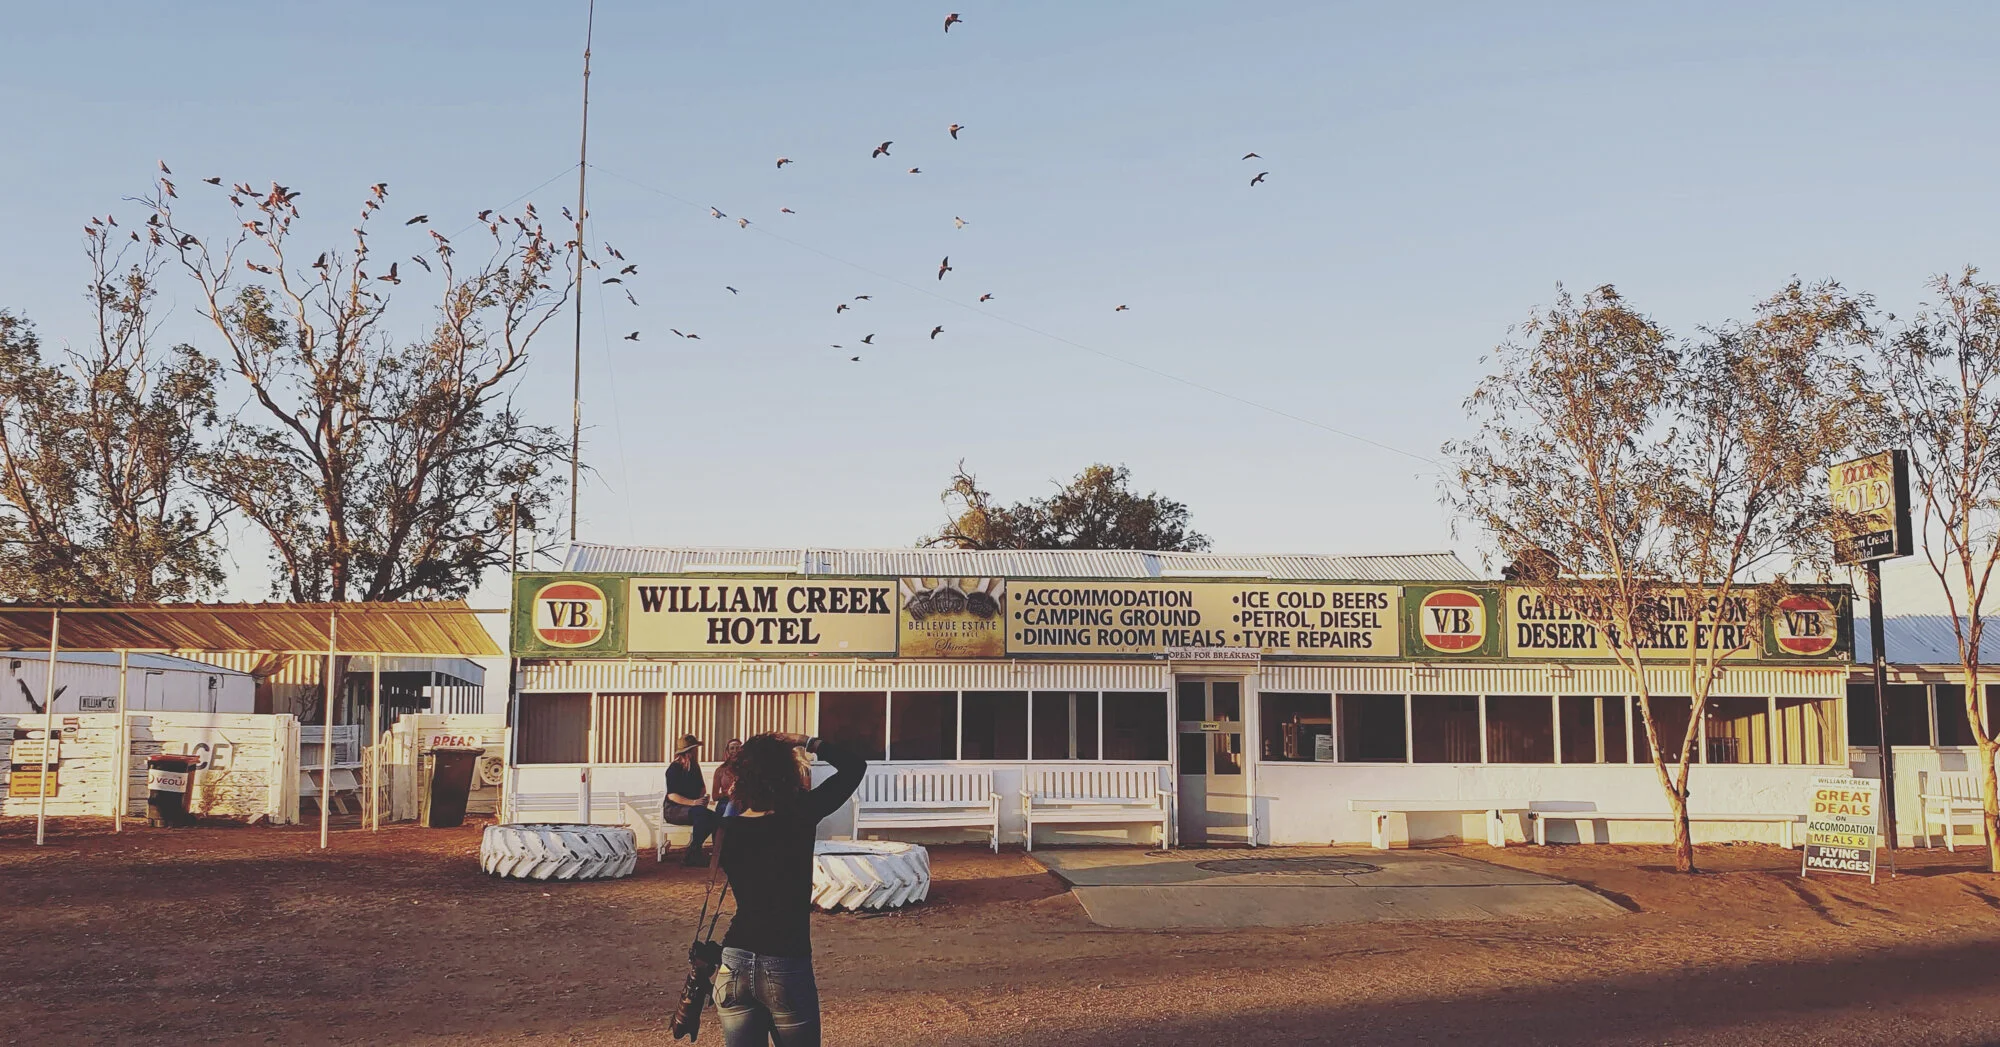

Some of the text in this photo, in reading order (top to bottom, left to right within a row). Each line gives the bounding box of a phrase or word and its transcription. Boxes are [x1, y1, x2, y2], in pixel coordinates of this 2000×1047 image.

[1842, 463, 1874, 485] XXXX
[1834, 480, 1890, 515] GOLD
[1867, 532, 1889, 546] Creek
[638, 586, 890, 614] WILLIAM CREEK
[1024, 589, 1192, 607] ACCOMMODATION
[1242, 592, 1388, 609] ICE COLD BEERS
[1517, 594, 1614, 620] GATEWAY
[547, 601, 592, 627] VB
[1024, 608, 1200, 626] CAMPING GROUND
[1242, 611, 1382, 630] PETROL, DIESEL
[1431, 608, 1473, 633] VB
[707, 617, 820, 644] HOTEL
[908, 621, 996, 630] BELLEVUE ESTATE
[1783, 611, 1826, 637] VB
[1024, 628, 1225, 647] DINING ROOM MEALS
[1243, 631, 1372, 648] TYRE REPAIRS
[1517, 623, 1597, 648] DESERT
[1696, 624, 1750, 649] EYRE
[934, 638, 968, 656] Shiraz
[1169, 651, 1191, 659] OPEN
[433, 736, 475, 746] BREAD
[1816, 789, 1871, 803] GREAT
[1815, 802, 1871, 816] DEALS
[1809, 821, 1875, 834] ACCOMODATION
[1814, 834, 1865, 846] MEALS &
[1820, 847, 1860, 859] FLYING
[1808, 856, 1870, 872] PACKAGES
